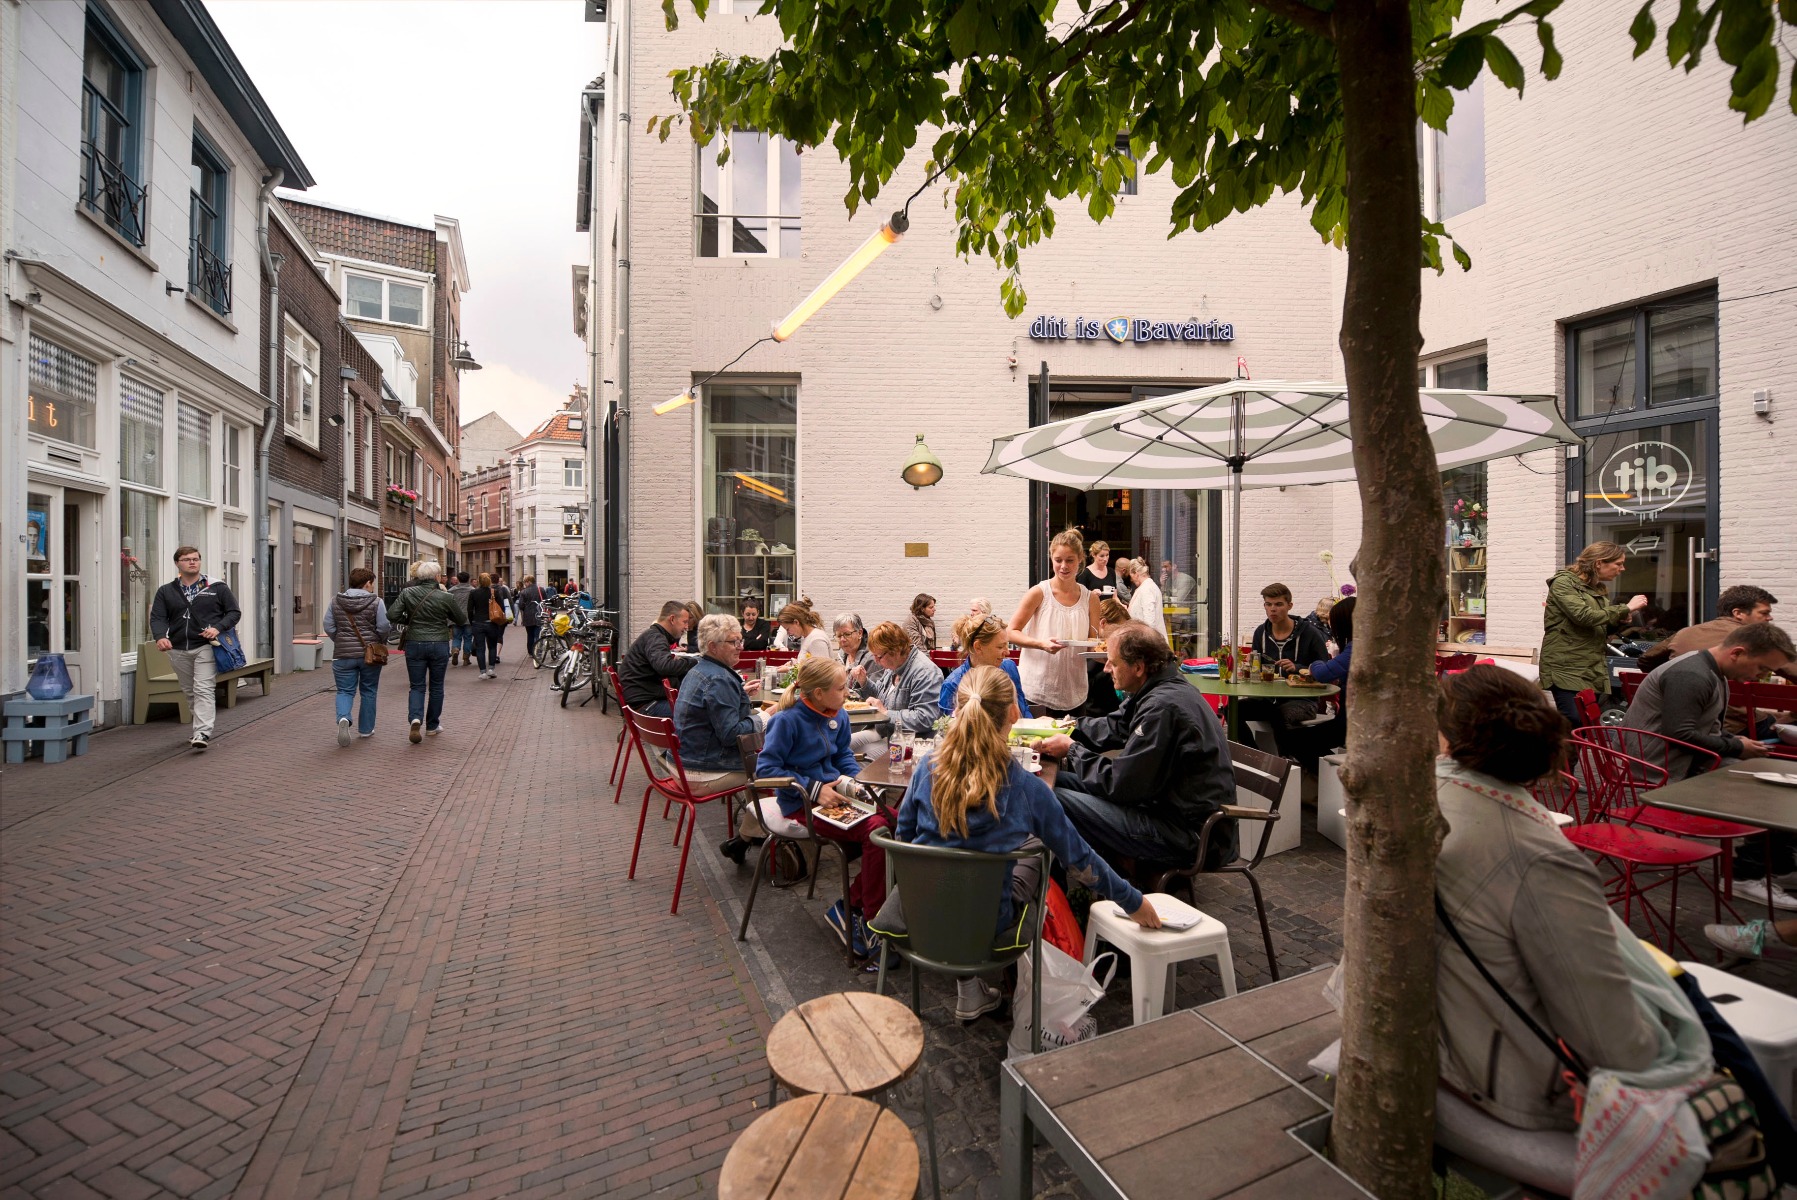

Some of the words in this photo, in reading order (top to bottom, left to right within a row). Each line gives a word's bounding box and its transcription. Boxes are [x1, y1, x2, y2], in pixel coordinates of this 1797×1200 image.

[1029, 315, 1068, 339] dit
[1076, 316, 1100, 339] is
[1134, 318, 1236, 342] Bavaria
[1614, 456, 1677, 497] tib
